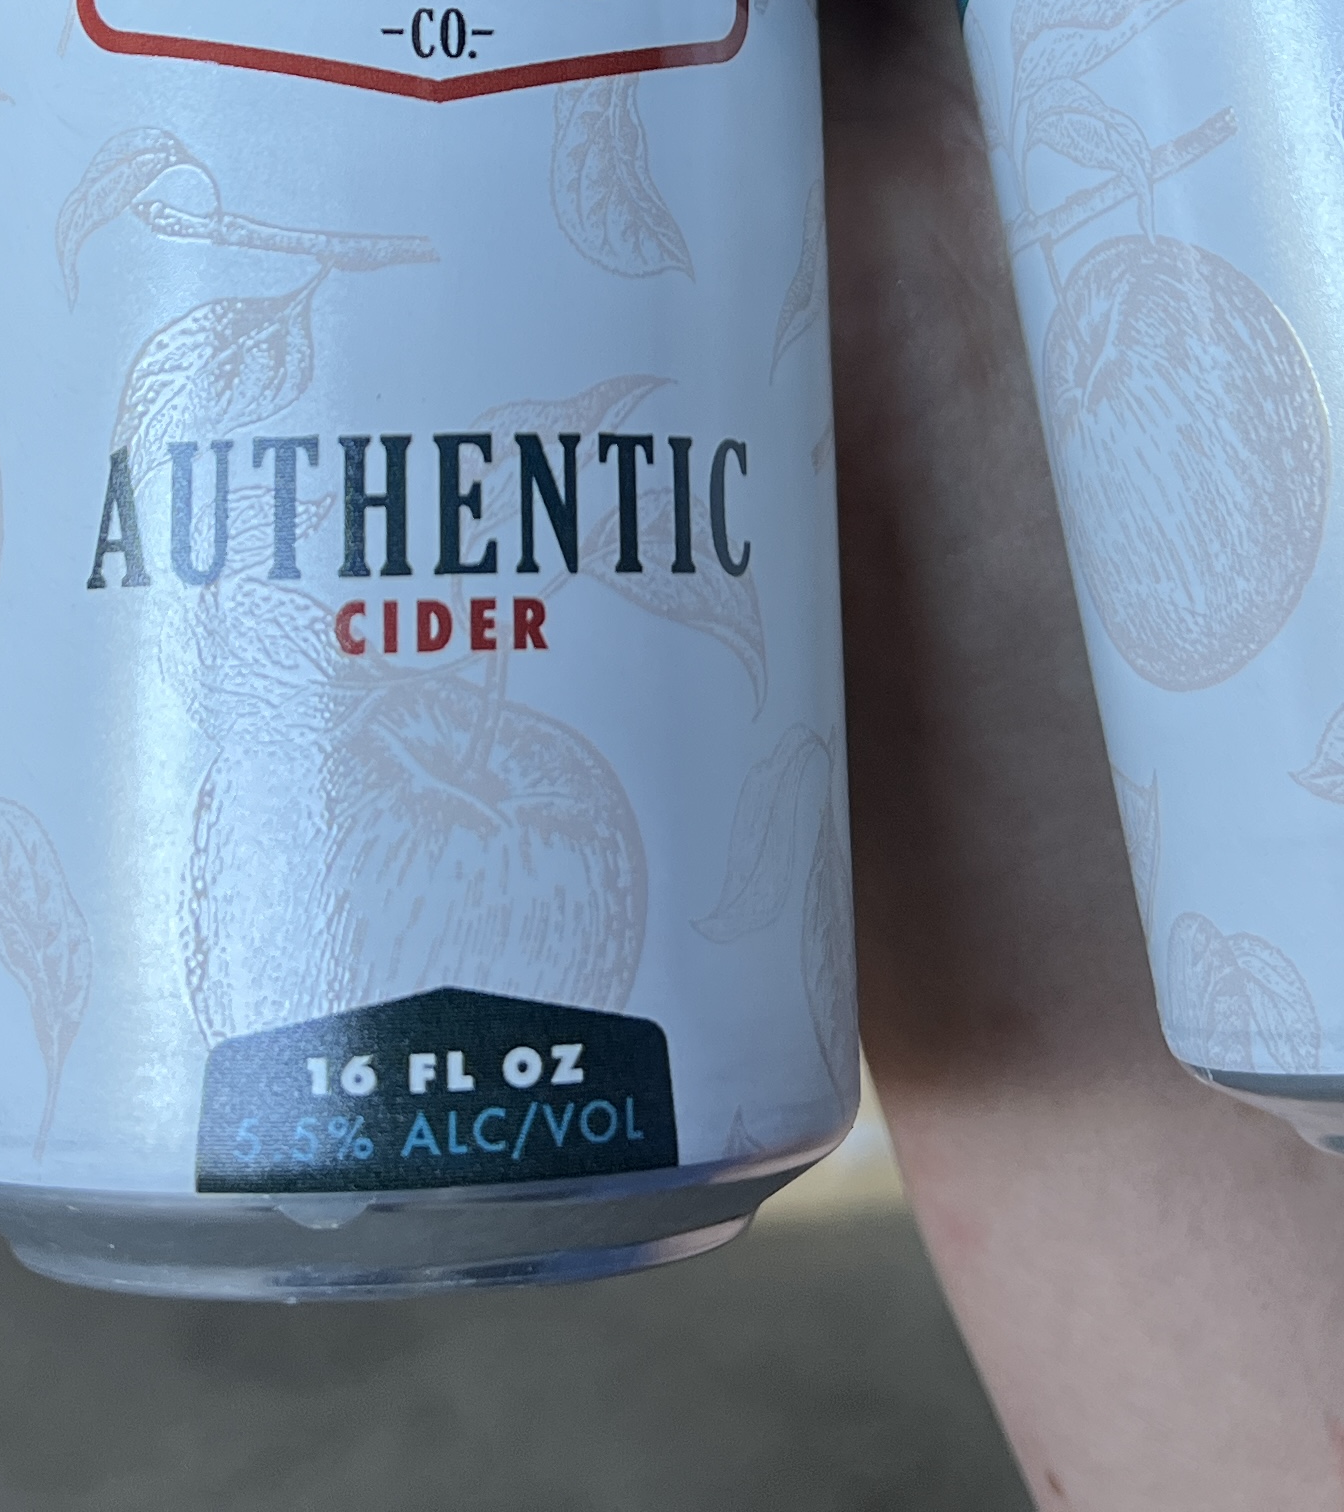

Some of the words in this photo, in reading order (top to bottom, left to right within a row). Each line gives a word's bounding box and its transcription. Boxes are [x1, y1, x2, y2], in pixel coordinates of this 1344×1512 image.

[85, 431, 752, 590] AUTHENTIC
[334, 596, 550, 656] CIDER
[305, 1053, 378, 1097] 16
[408, 1049, 476, 1095] FL
[502, 1042, 585, 1089] OZ
[233, 1113, 375, 1163] 5.5%
[399, 1095, 646, 1161] ALC/VOL
